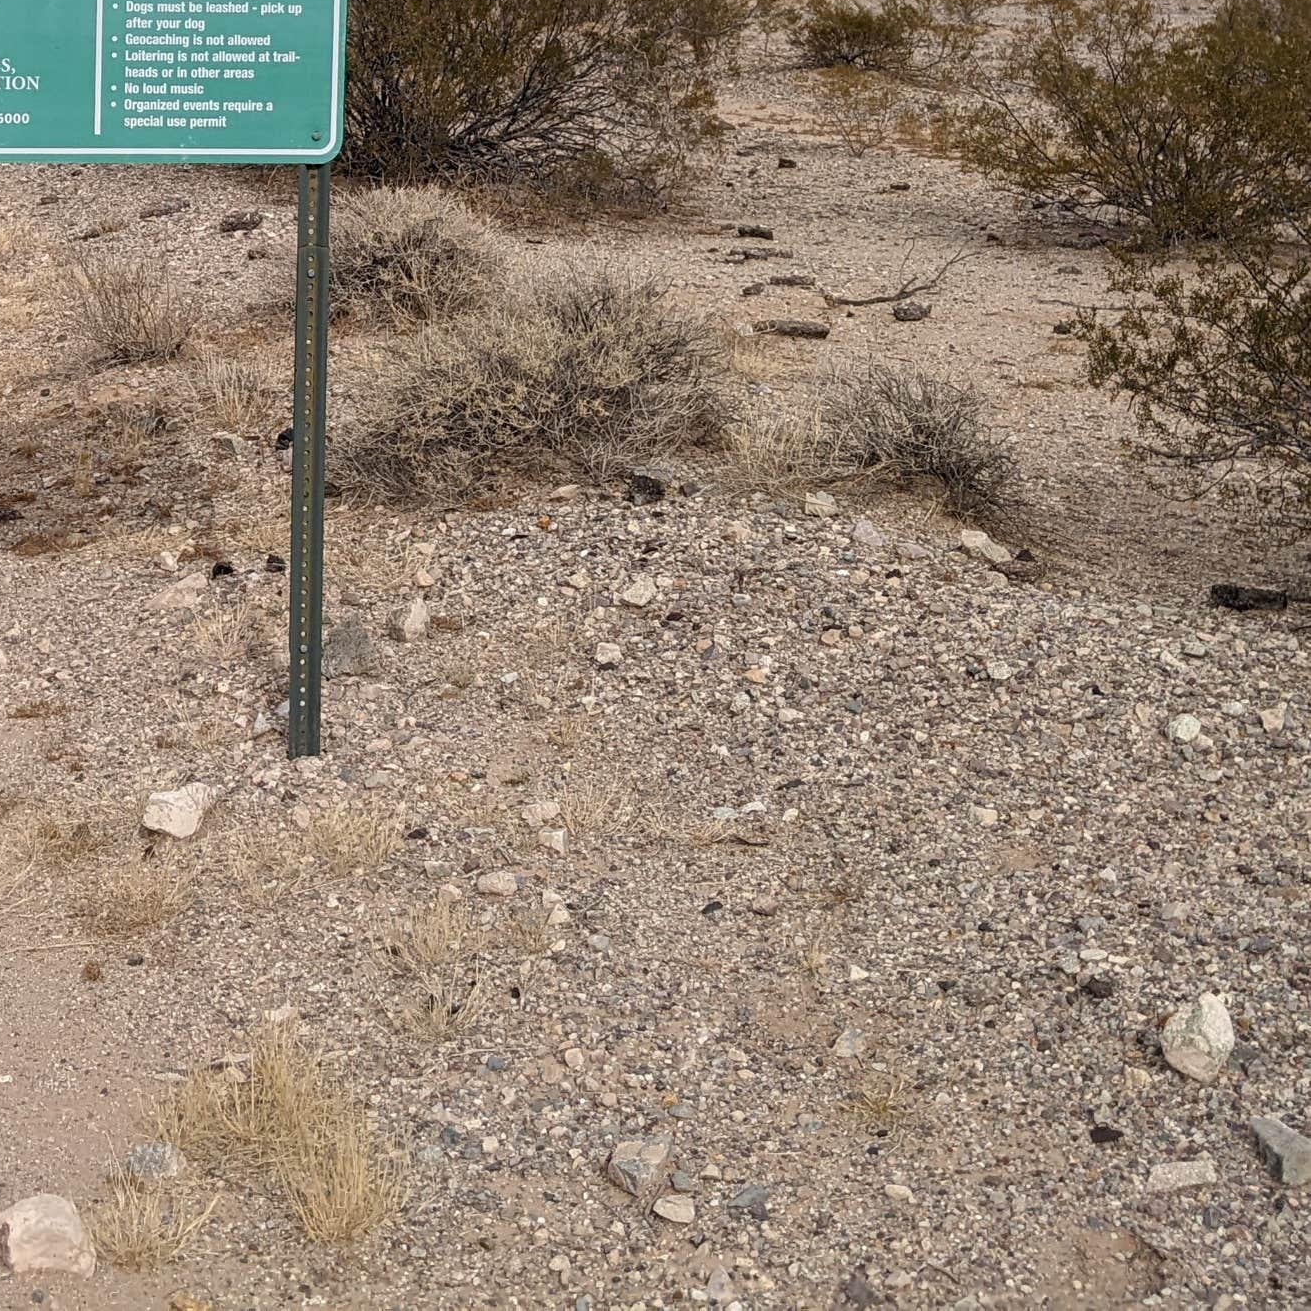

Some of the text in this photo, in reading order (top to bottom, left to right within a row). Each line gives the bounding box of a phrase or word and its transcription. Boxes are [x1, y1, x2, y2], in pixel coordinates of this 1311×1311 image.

[126, 0, 154, 14] Dogs
[157, 1, 185, 13] must
[188, 1, 203, 13] be
[205, 1, 249, 13] leashed
[260, 1, 285, 15] pick
[287, 4, 302, 16] up
[125, 16, 205, 32] after your dog
[125, 33, 271, 48] Geocaching is not allowed
[125, 49, 300, 64] Loitering is not allowed at trail-
[124, 65, 254, 79] heads or in other areas
[124, 82, 204, 94] No loud music
[123, 98, 273, 113] Organized events require a
[123, 115, 227, 129] special use permit
